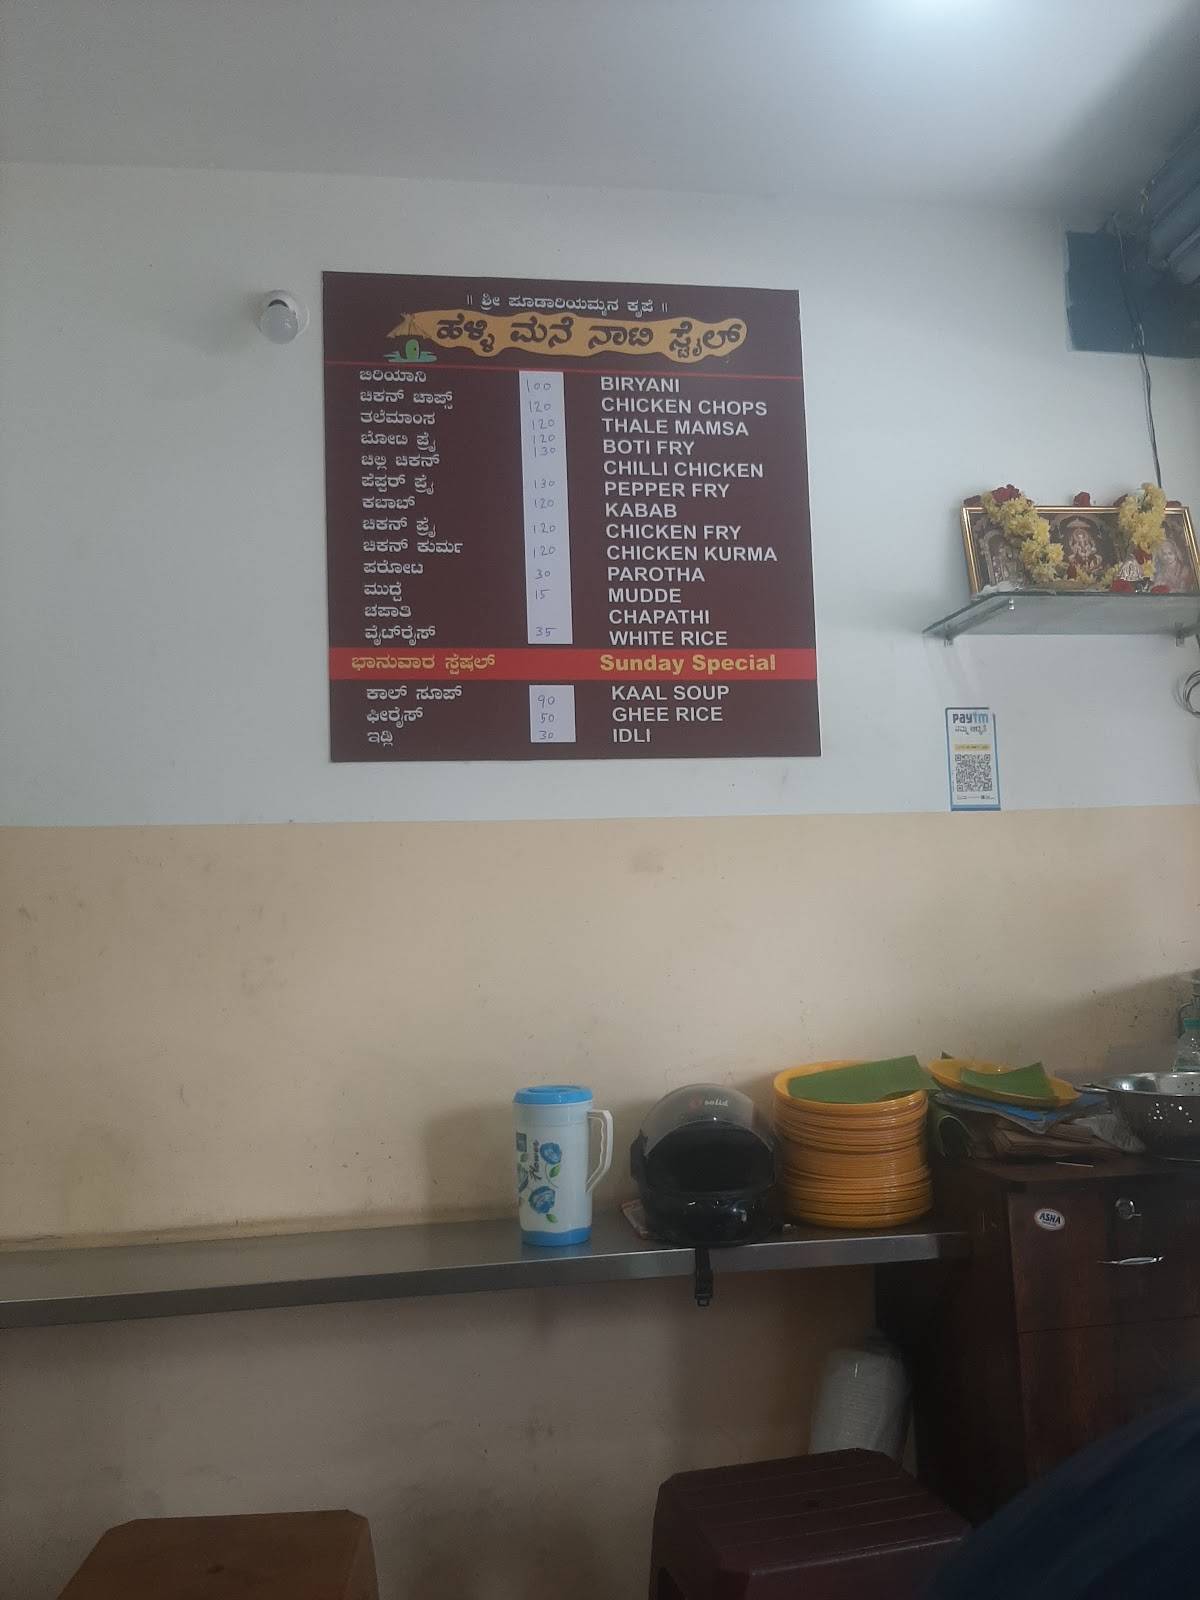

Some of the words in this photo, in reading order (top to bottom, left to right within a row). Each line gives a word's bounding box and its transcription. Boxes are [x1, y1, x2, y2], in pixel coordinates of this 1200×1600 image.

[480, 292, 500, 311] ಶ್ರೀ
[627, 299, 654, 318] ಕೃಪೆ
[436, 312, 495, 353] ಹಳ್ಳಿ
[510, 316, 575, 348] ಮನೆ
[587, 323, 654, 350] ನಾಟಿ
[668, 320, 744, 359] ಸ್ಟೈಲ್
[360, 369, 427, 383] ಬಿರಿಯಾನಿ
[526, 379, 552, 392] 100
[600, 376, 680, 393] BIRYANI
[360, 388, 405, 402] ಚಿಕನ್
[529, 401, 552, 413] 120
[601, 397, 692, 414] CHICKEN
[698, 400, 768, 416] CHOPS
[360, 409, 436, 425] ತಲೆಮಾಂಸ
[532, 418, 555, 430] 120
[601, 418, 668, 434] THALE
[674, 420, 749, 436] MAMSA
[361, 430, 409, 445] ಬೋಟಿ
[533, 434, 556, 444] 120
[534, 446, 556, 458] 130
[603, 439, 650, 455] BOTI
[656, 440, 695, 456] FRY
[361, 454, 387, 470] ಚಿಲ್ಲಿ
[395, 454, 440, 467] ಚಿಕನ್
[603, 460, 668, 476] CHILLI
[674, 461, 764, 478] CHICKEN
[361, 473, 406, 492] ಪೆಪ್ಪರ್
[534, 479, 556, 489] 130
[604, 481, 686, 497] PEPPER
[691, 483, 730, 498] FRY
[362, 496, 415, 509] ಕಬಾಬ್
[534, 498, 555, 509] 120
[605, 502, 677, 518] KABAB
[362, 516, 408, 530] ಚಿಕನ್
[533, 522, 556, 534] 120
[605, 524, 697, 540] CHICKEN
[703, 525, 742, 541] FRY
[363, 538, 409, 552] ಚಿಕನ್
[417, 540, 463, 554] ಕುರ್ಮ
[533, 545, 556, 558] 120
[606, 545, 698, 561] CHICKEN
[704, 547, 778, 562] KURMA
[363, 560, 424, 574] ಪರೋಟ
[535, 569, 551, 579] 30
[607, 566, 705, 582] PAROTHA
[364, 582, 402, 602] ಮುದ್ದೆ
[535, 589, 550, 600] 15
[608, 588, 682, 604] MUDDE
[364, 604, 412, 617] ಚಪಾತಿ
[609, 609, 710, 625] CHAPATHI
[535, 626, 559, 637] 35
[609, 630, 674, 646] WHITE
[681, 631, 728, 646] RICE
[351, 654, 436, 671] ಭಾನುವಾರ
[445, 653, 496, 675] ಸ್ಪೆಷಲ್
[600, 654, 685, 675] Sunday
[692, 654, 776, 675] Special
[366, 685, 408, 700] ಕಾಲ್
[416, 685, 463, 700] ಸೂಪ್
[611, 685, 668, 700] KAAL
[673, 685, 730, 700] SOUP
[537, 694, 555, 709] 90
[541, 712, 555, 723] 50
[612, 707, 669, 722] GHEE
[676, 706, 723, 721] RICE
[367, 730, 393, 746] ಇಡ್ಲಿ
[539, 730, 554, 740] 30
[613, 728, 651, 743] IDLI
[1039, 1212, 1061, 1225] ASHA
